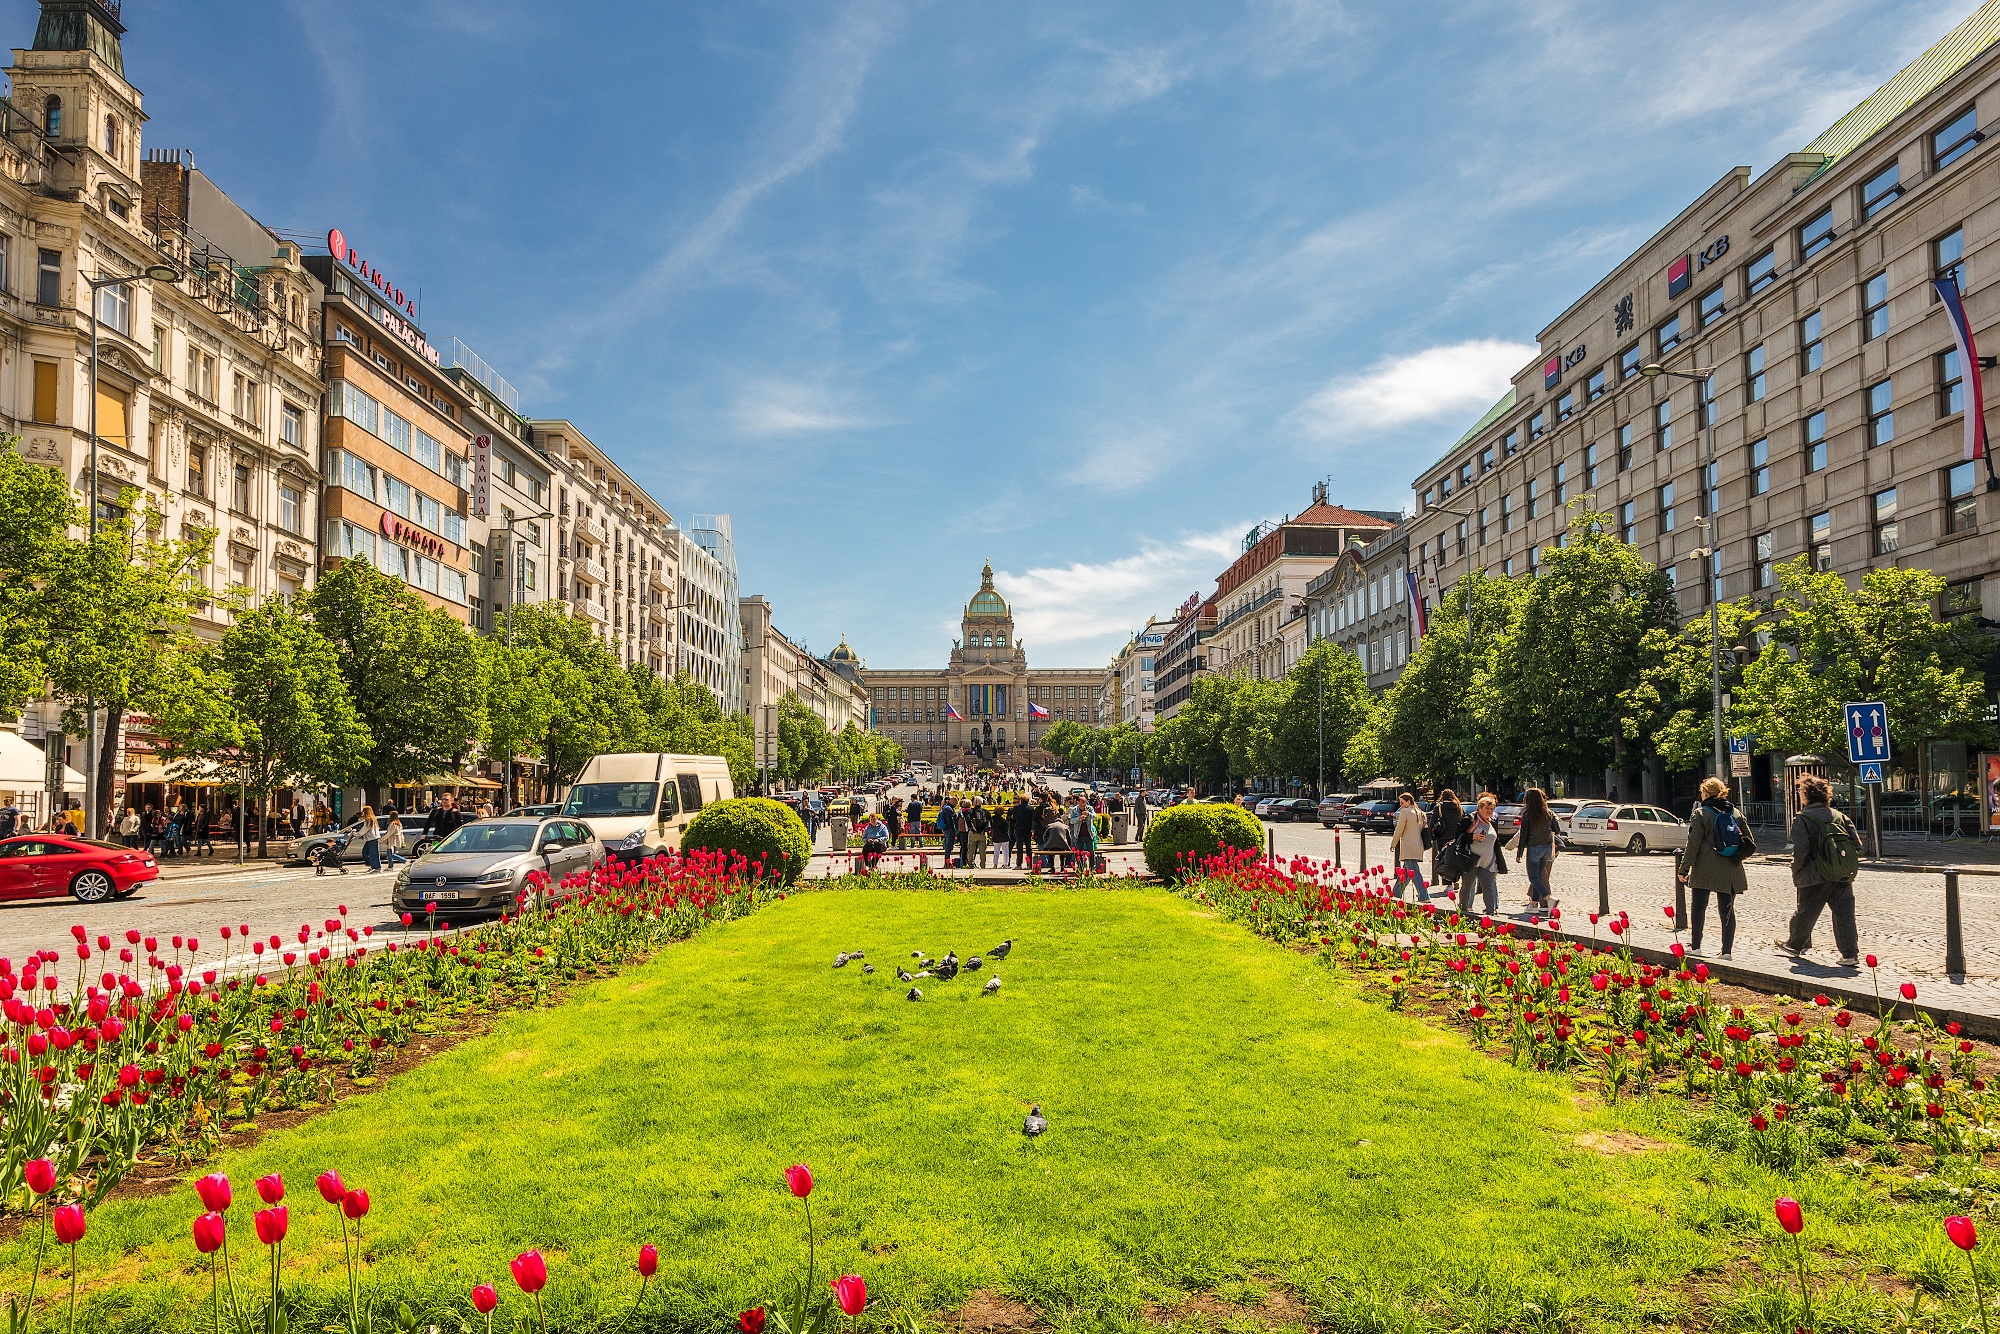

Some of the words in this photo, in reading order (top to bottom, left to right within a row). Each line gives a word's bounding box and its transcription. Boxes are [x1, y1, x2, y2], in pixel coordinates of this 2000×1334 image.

[1696, 234, 1730, 273] KB
[348, 248, 415, 317] RAMADA
[382, 308, 415, 347] PALÁC
[415, 335, 440, 368] KNIH
[1563, 344, 1587, 373] KB
[478, 454, 487, 515] RAMADA
[394, 521, 446, 556] RAMADA
[1141, 634, 1163, 643] invia
